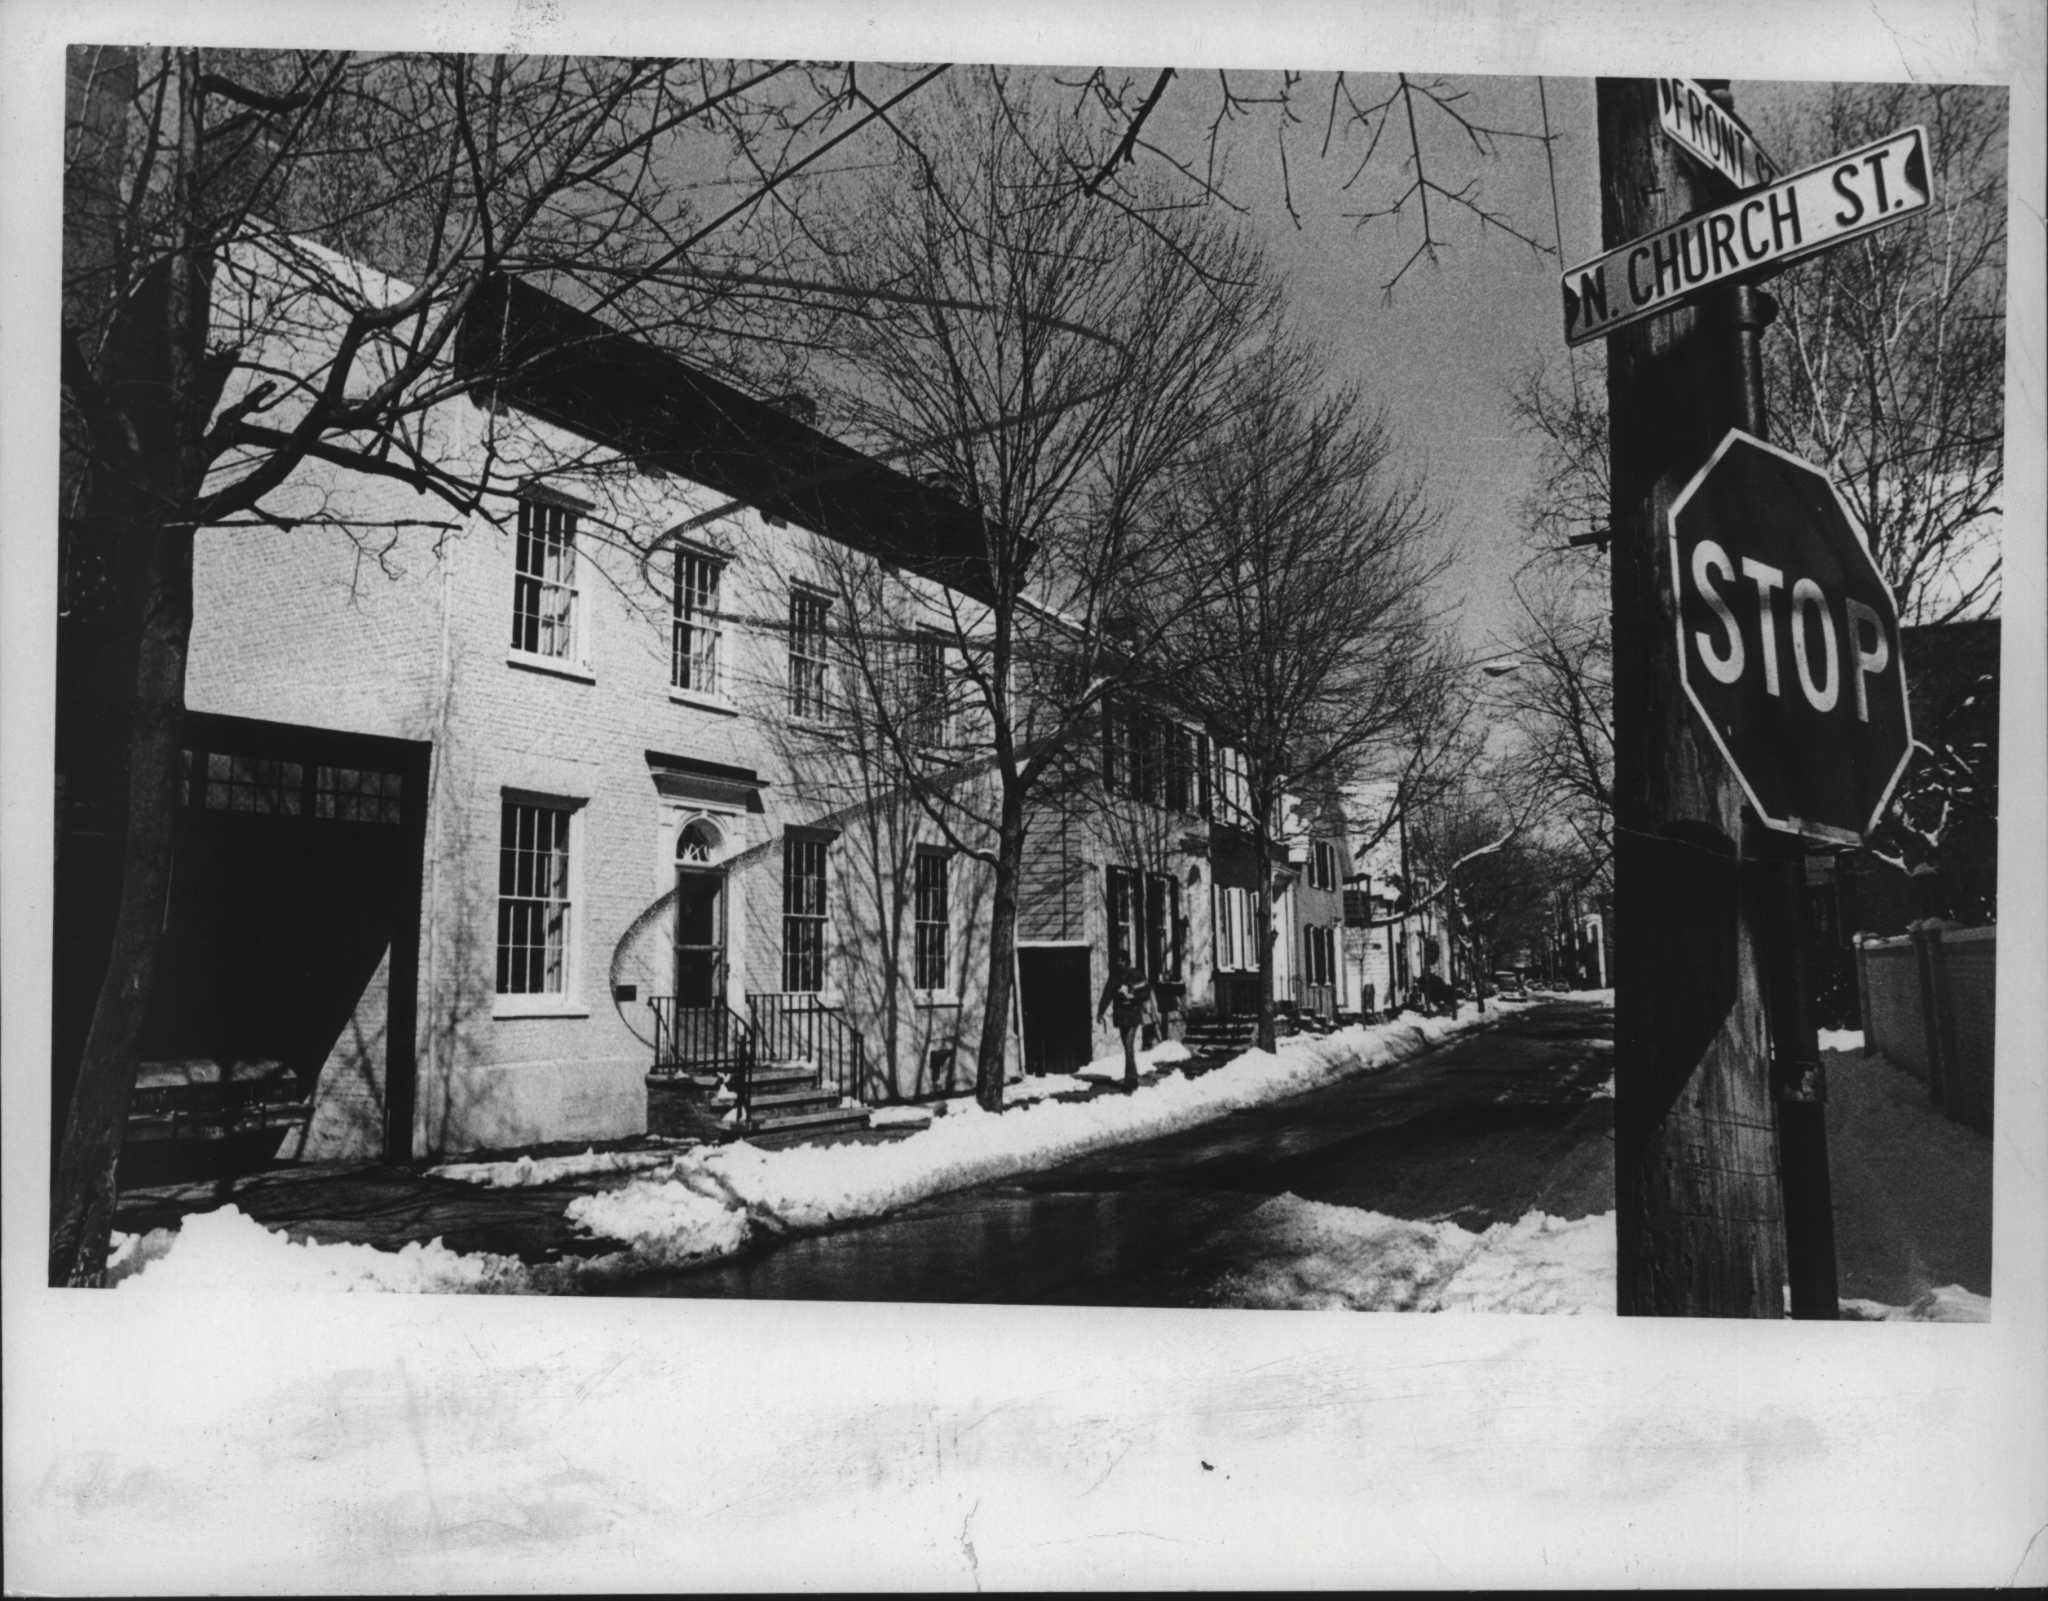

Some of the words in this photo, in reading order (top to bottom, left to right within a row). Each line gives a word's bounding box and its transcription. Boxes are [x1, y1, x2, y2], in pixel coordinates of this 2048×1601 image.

[1672, 78, 1745, 186] FRONT
[1579, 265, 1619, 327] N.
[1627, 186, 1802, 305] CHURCH
[1831, 149, 1904, 226] ST.
[1691, 539, 1889, 723] STOP
